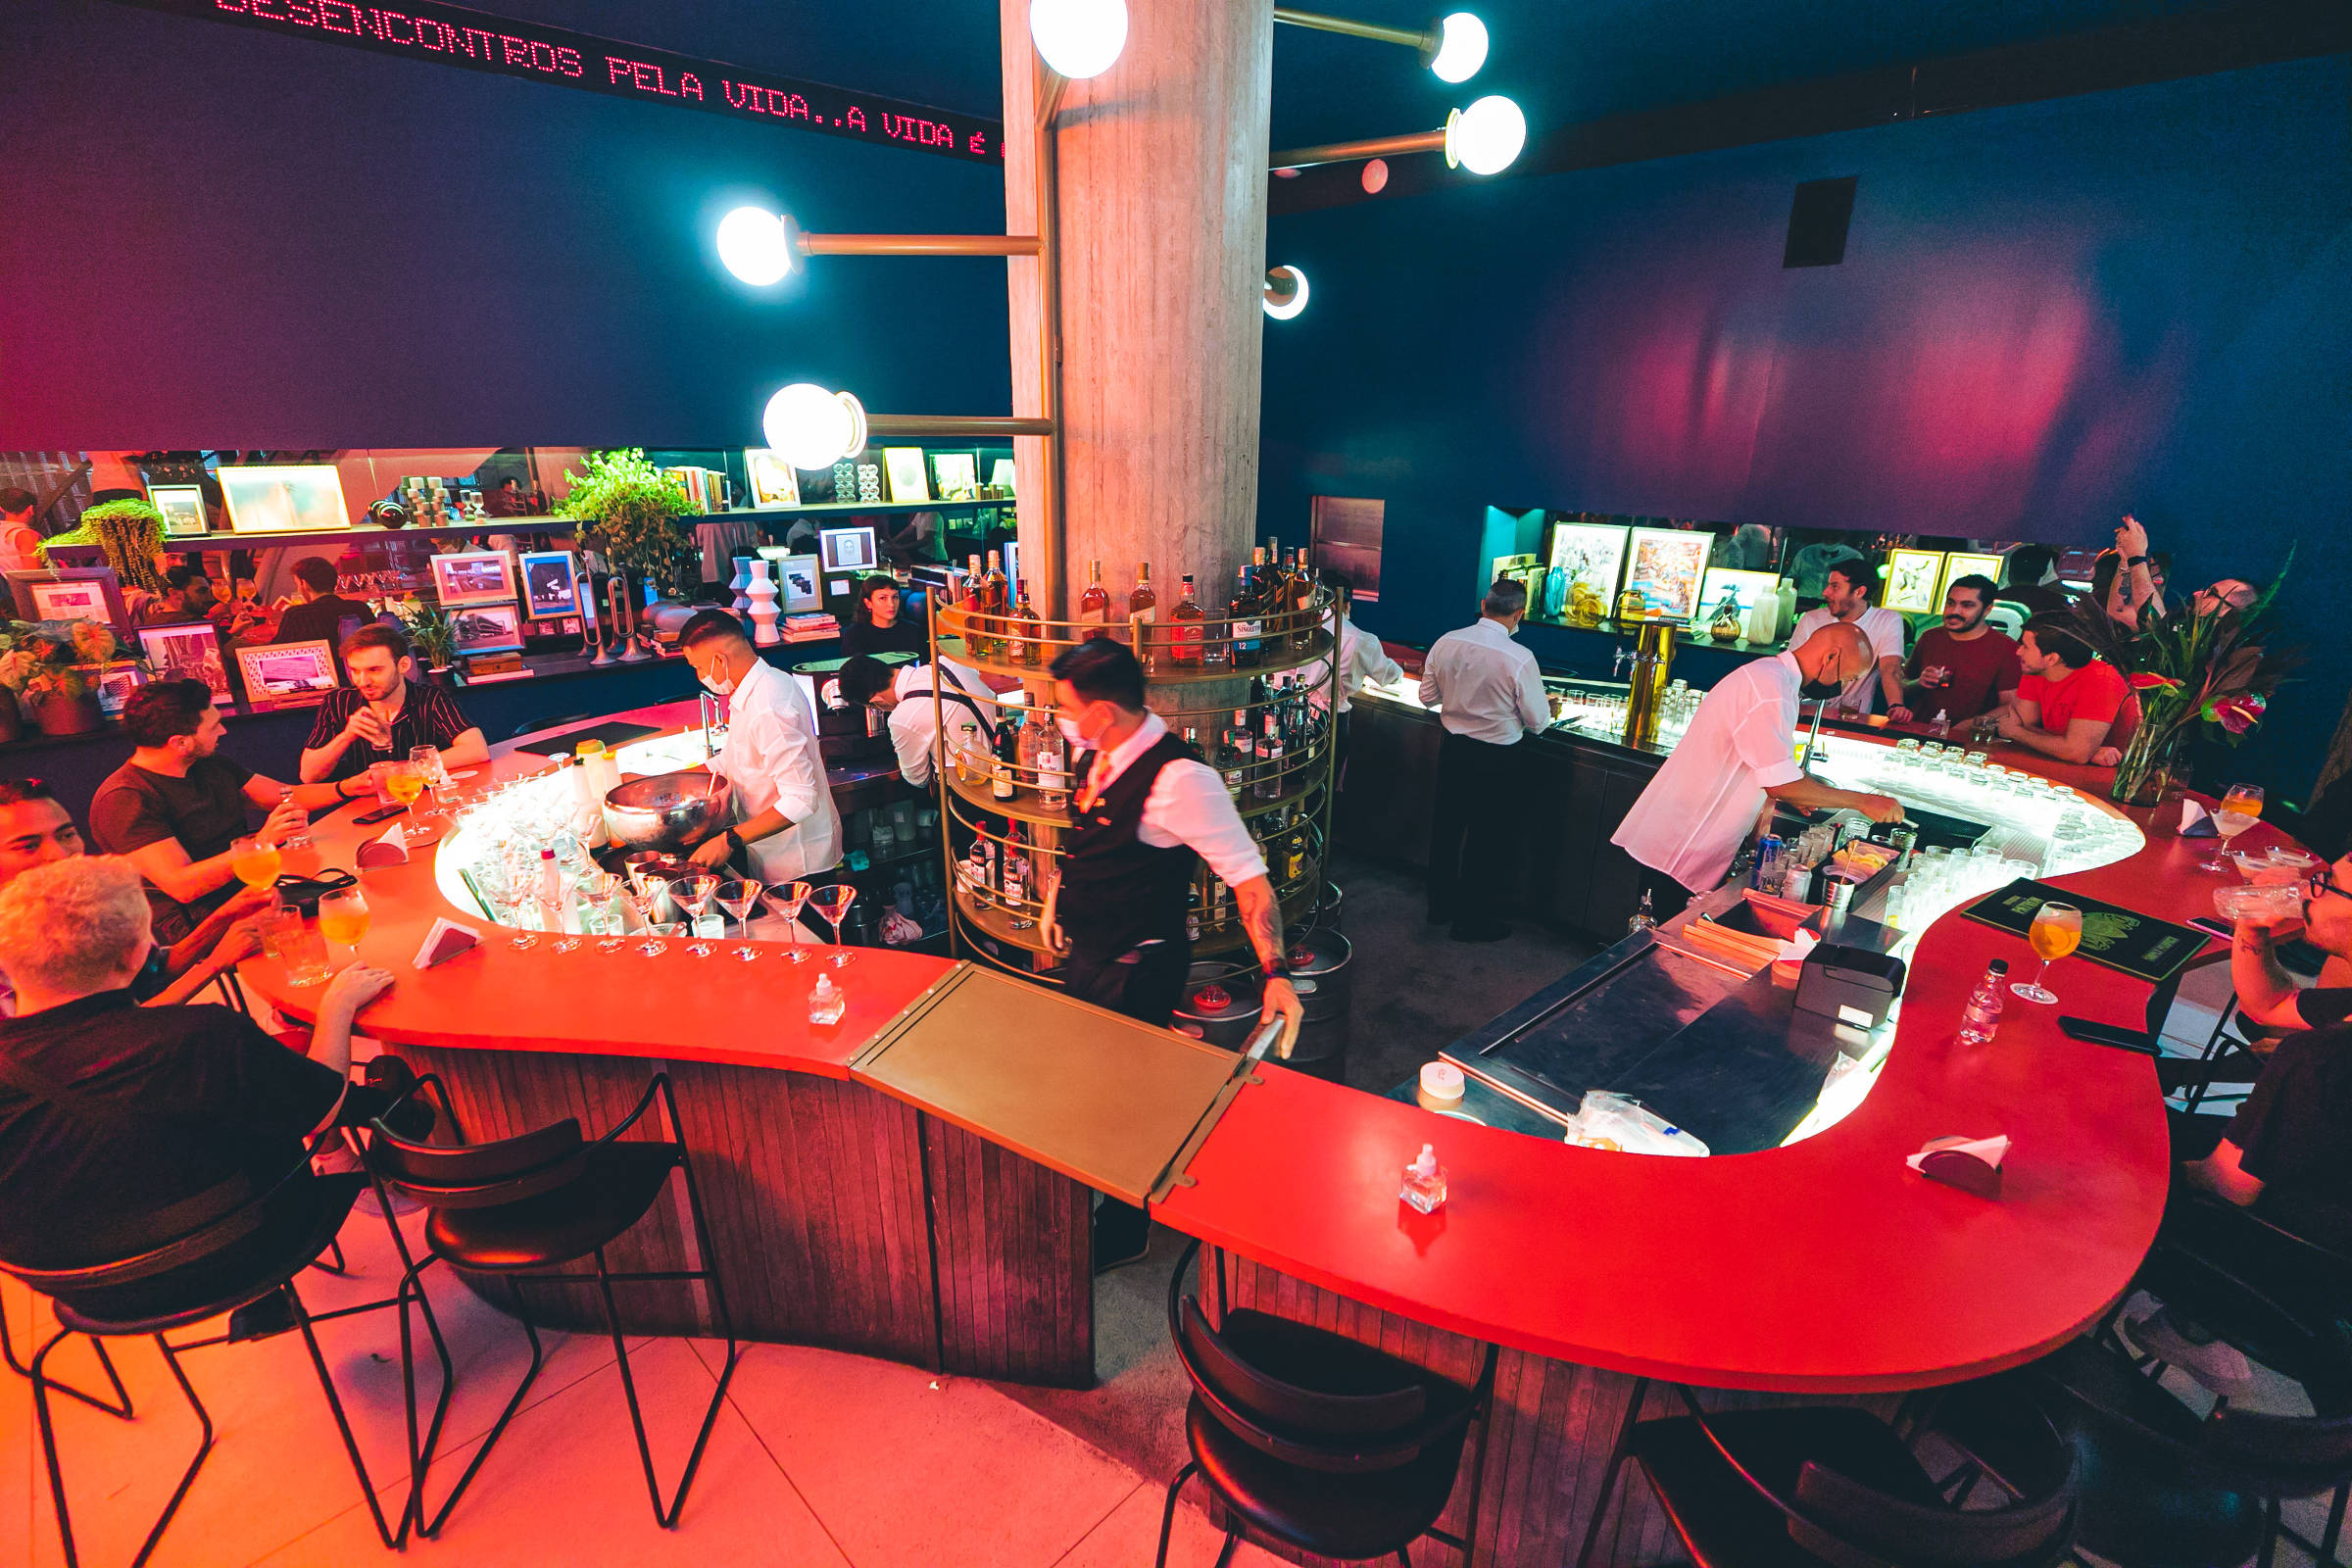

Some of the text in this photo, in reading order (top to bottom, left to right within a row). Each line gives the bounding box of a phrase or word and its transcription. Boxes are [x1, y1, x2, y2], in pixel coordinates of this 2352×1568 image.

[605, 56, 704, 101] PELA
[882, 113, 954, 148] VIDA
[969, 131, 986, 154] É
